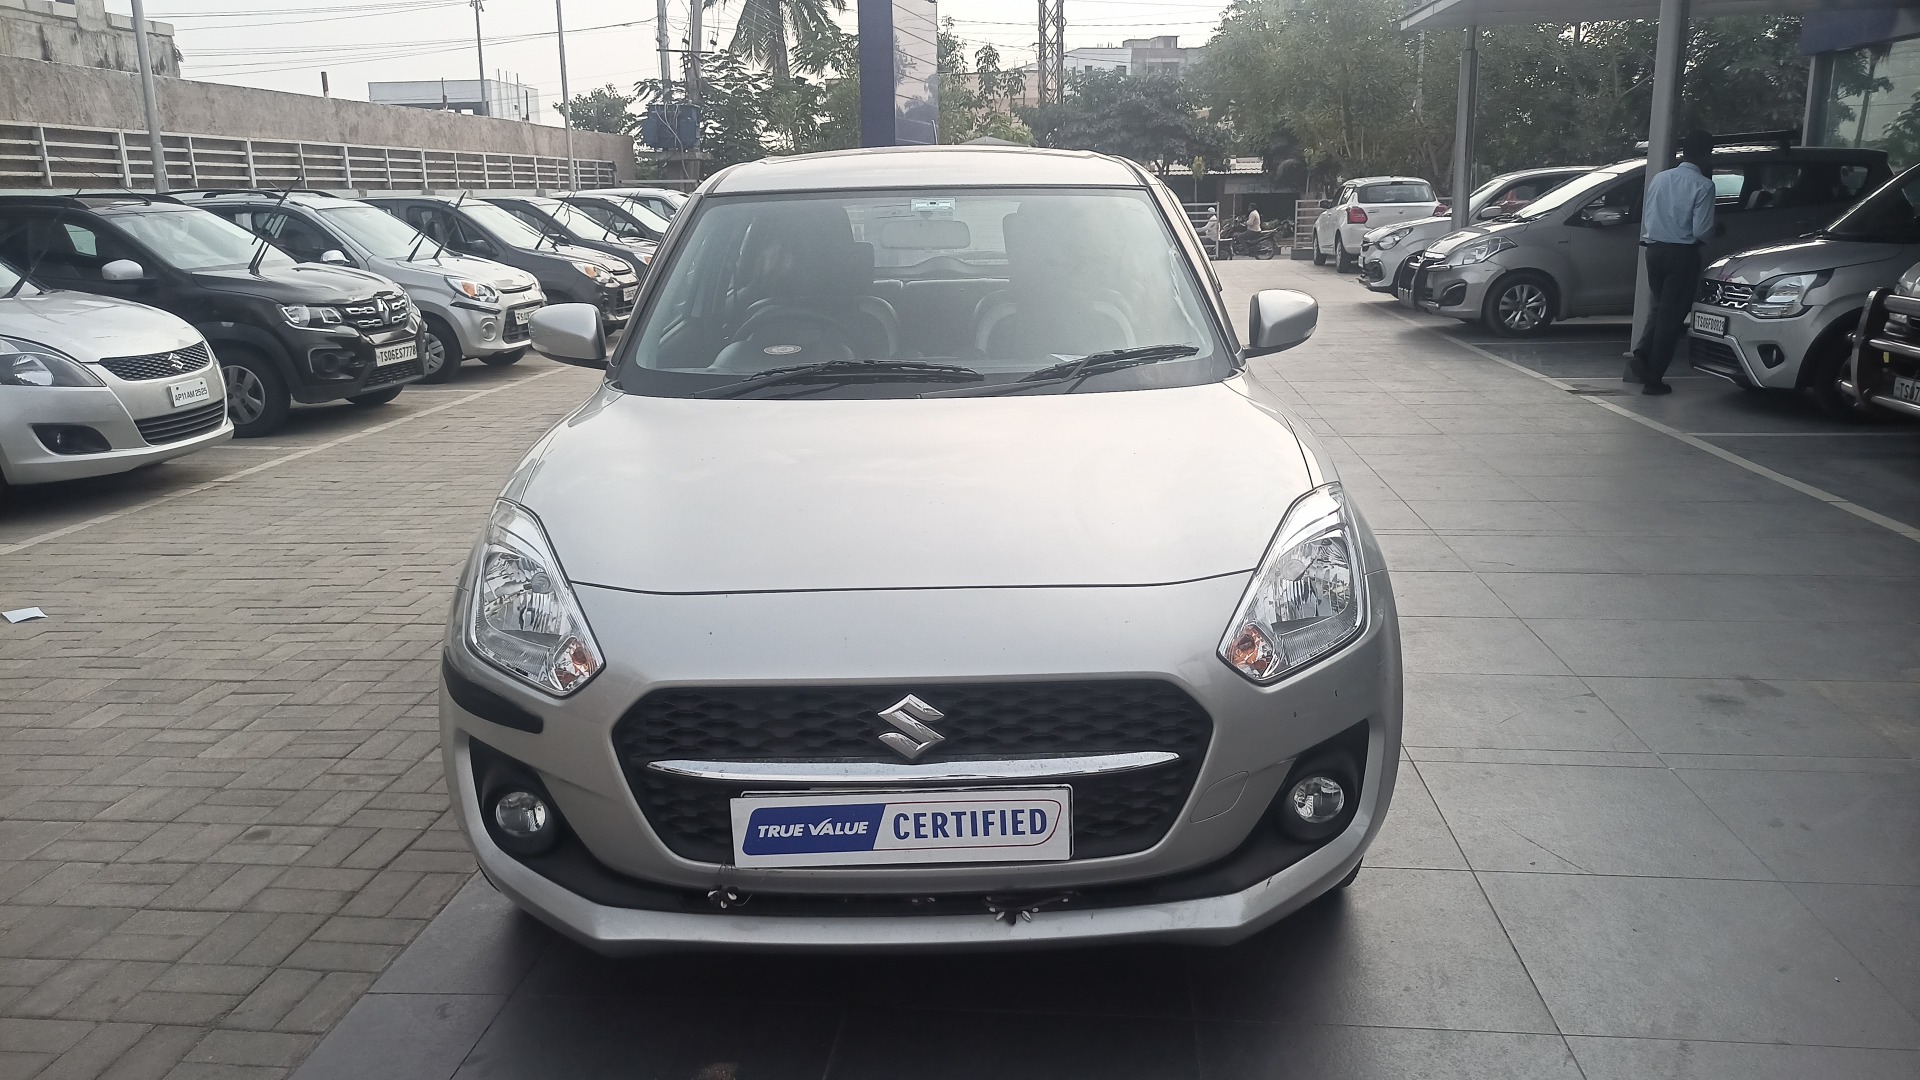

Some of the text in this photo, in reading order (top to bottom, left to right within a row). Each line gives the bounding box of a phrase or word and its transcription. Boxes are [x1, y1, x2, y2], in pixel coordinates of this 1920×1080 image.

[757, 807, 1048, 840] TRUE VALUE CERTIFIED
